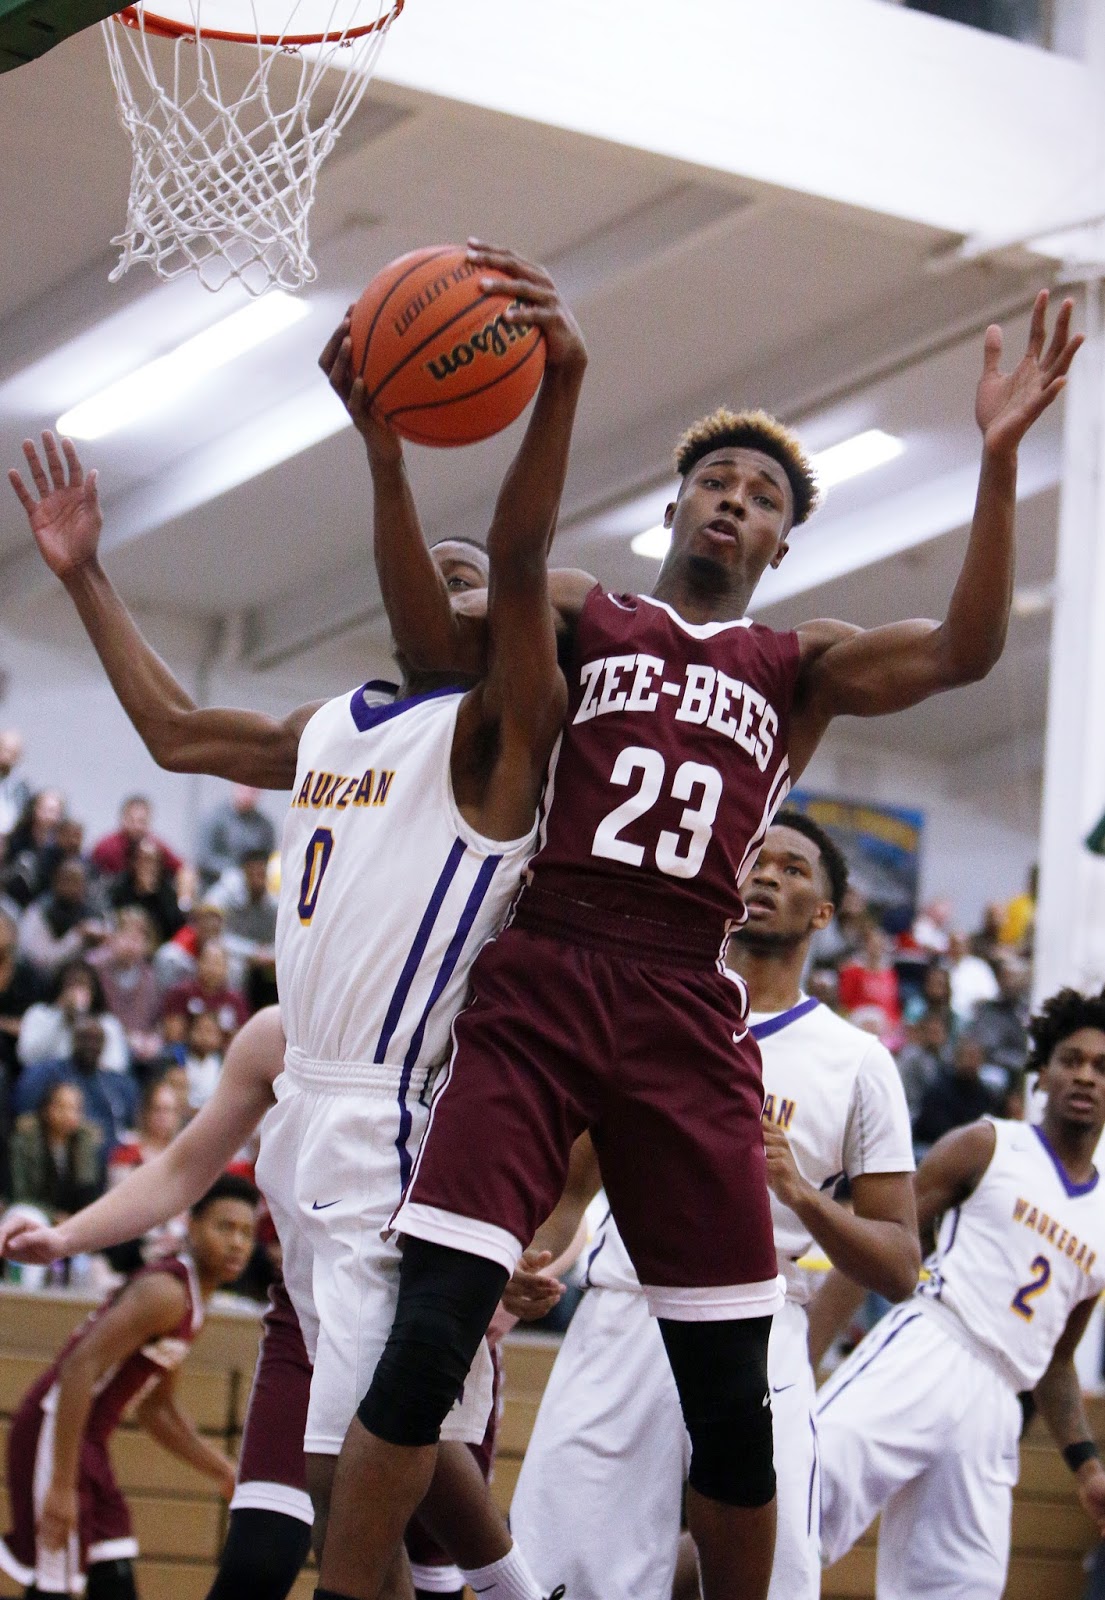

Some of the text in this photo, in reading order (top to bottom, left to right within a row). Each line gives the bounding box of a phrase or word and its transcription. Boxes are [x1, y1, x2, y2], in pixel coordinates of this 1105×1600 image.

[393, 259, 477, 337] VOLUTION
[572, 653, 778, 773] ZEE-BEES
[591, 745, 723, 880] 23
[297, 825, 335, 927] 0
[1010, 1252, 1052, 1324] 2
